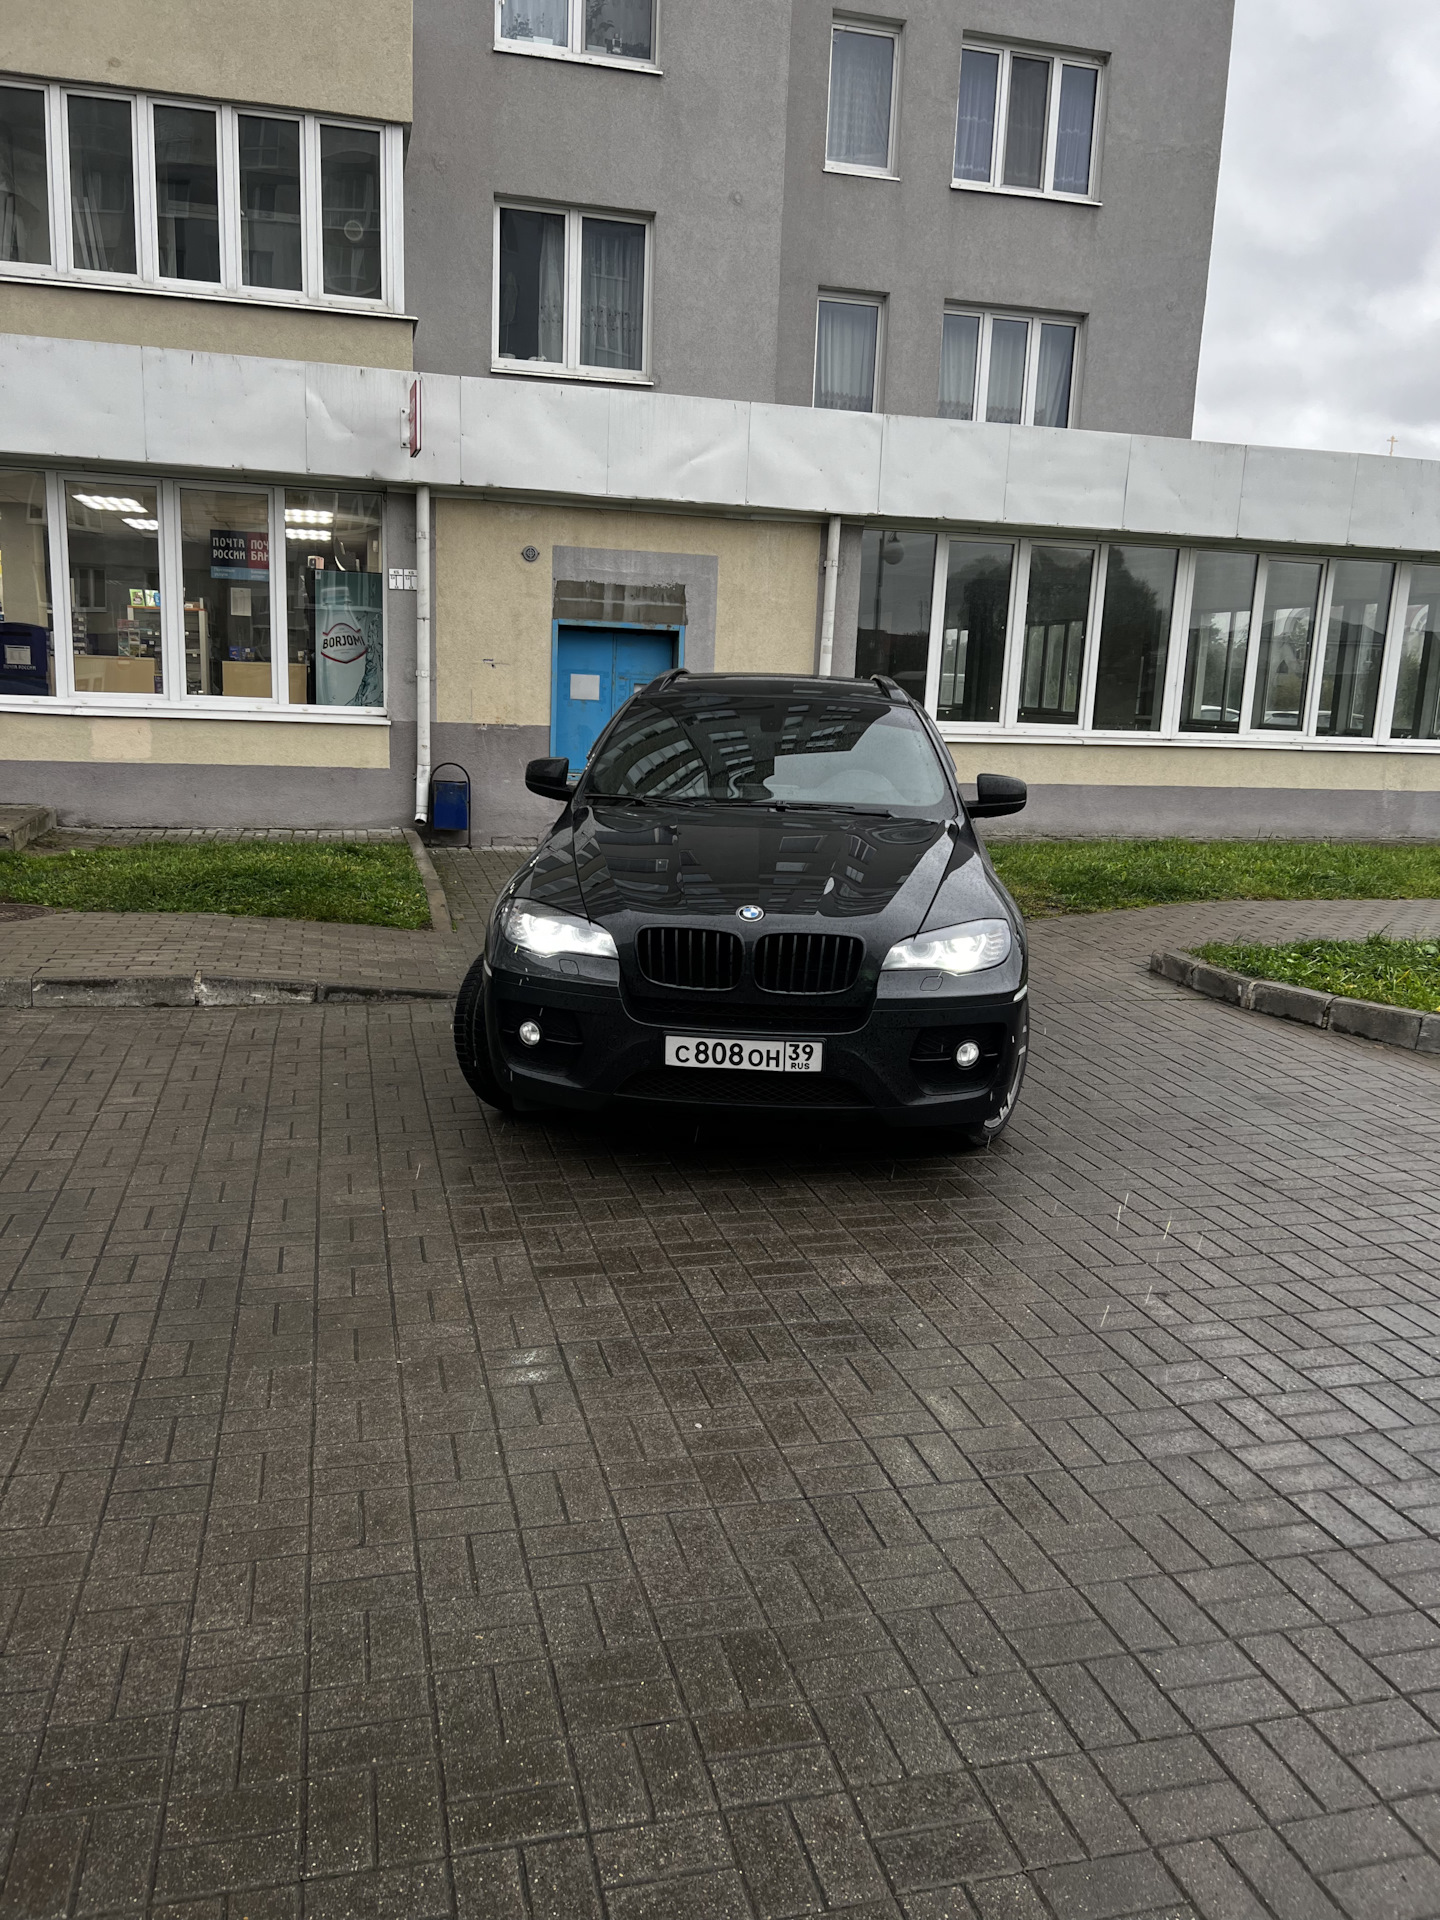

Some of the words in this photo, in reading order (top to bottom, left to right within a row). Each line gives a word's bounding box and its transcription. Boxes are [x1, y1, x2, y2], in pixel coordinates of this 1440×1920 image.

[212, 537, 245, 548] ПОЧТА
[250, 539, 269, 550] ПОЧ
[212, 549, 246, 560] РОССИИ
[250, 550, 269, 562] БАН
[322, 635, 366, 649] BORJOMI
[788, 1043, 814, 1062] 39
[790, 1062, 811, 1071] RUS
